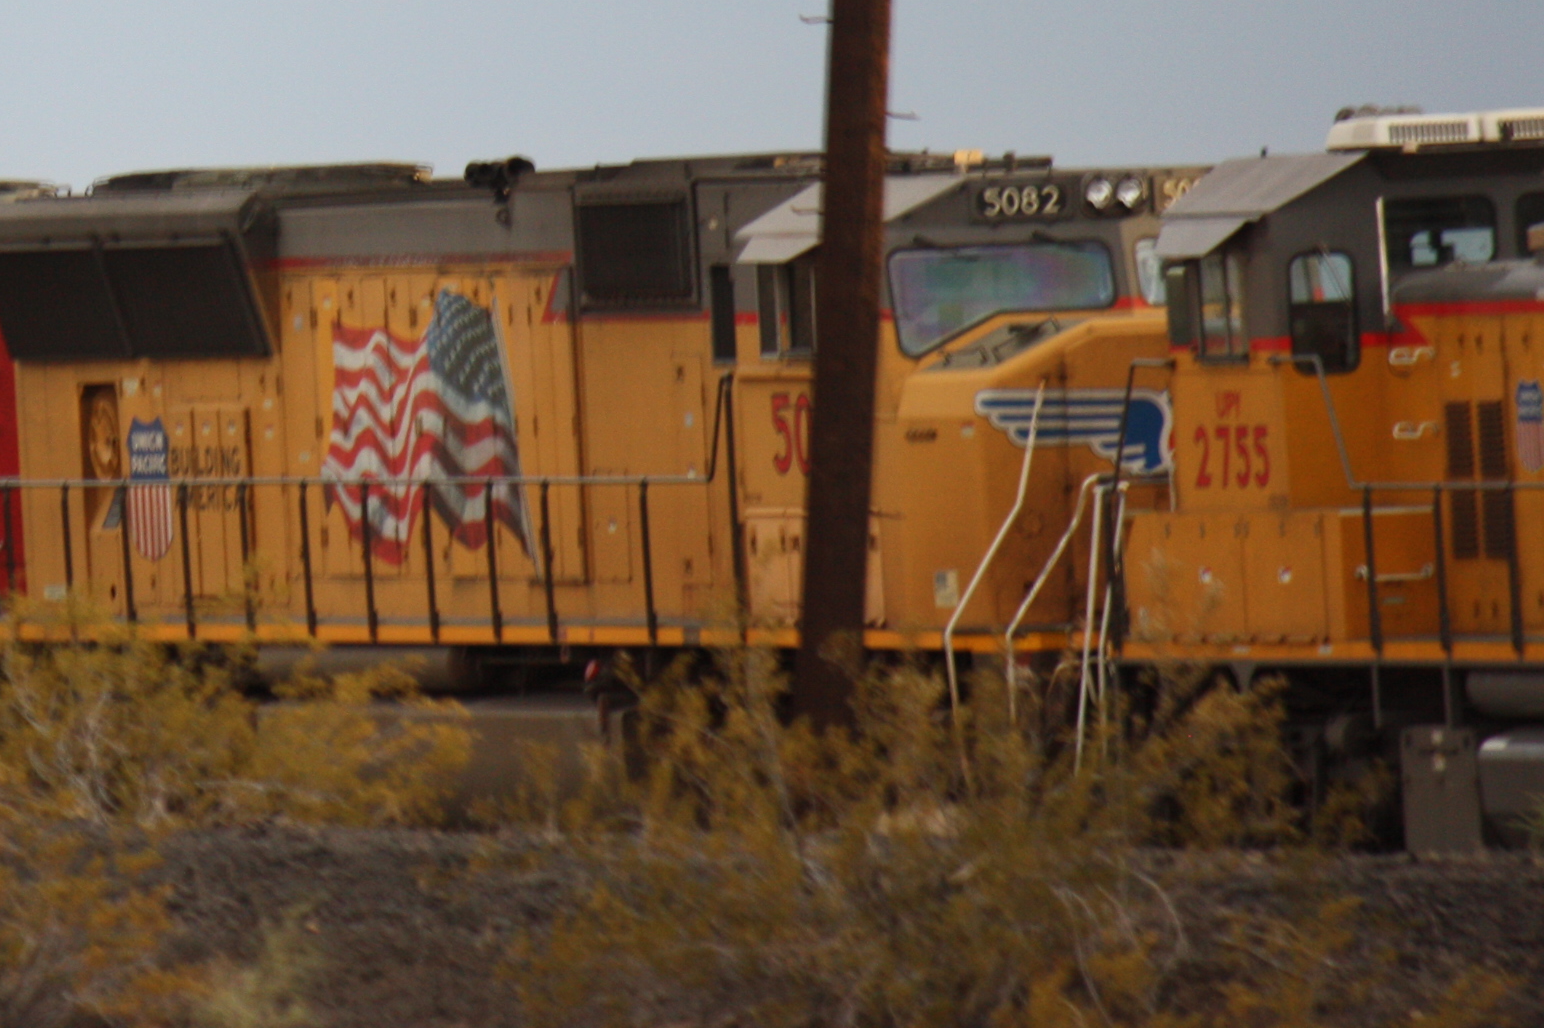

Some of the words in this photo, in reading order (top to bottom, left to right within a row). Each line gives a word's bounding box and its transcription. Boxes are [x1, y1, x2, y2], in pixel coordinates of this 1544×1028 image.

[983, 184, 1061, 217] 5082
[770, 392, 813, 476] 50
[1194, 424, 1271, 490] 2755
